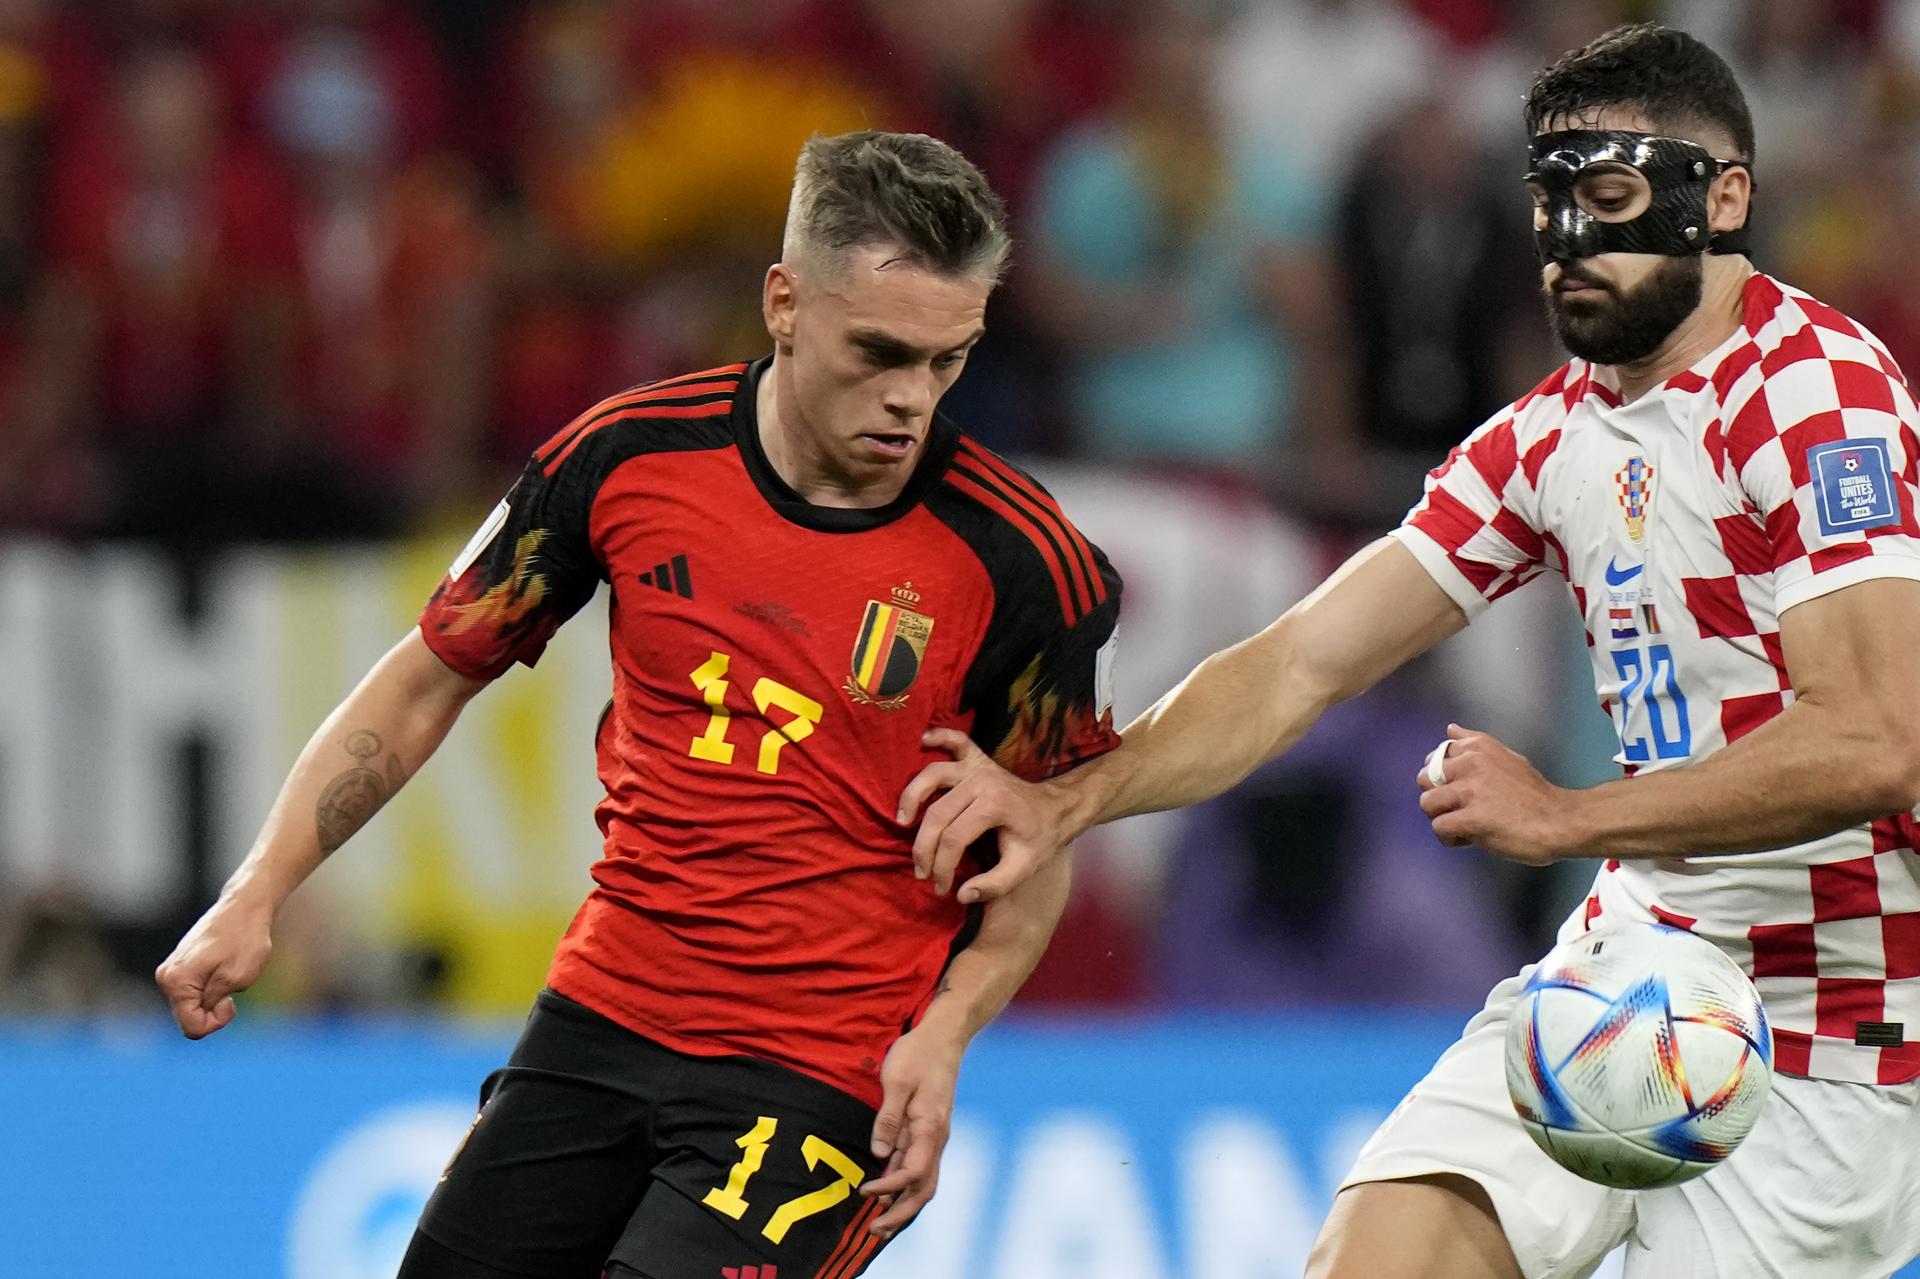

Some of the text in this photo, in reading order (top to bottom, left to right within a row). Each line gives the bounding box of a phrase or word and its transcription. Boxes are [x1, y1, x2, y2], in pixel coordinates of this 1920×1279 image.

[1839, 475, 1871, 487] FOOTBALL
[1841, 483, 1873, 499] UNITES
[1854, 494, 1876, 507] World
[688, 651, 824, 775] 17
[1610, 644, 1691, 761] 20
[702, 1116, 865, 1245] 17
